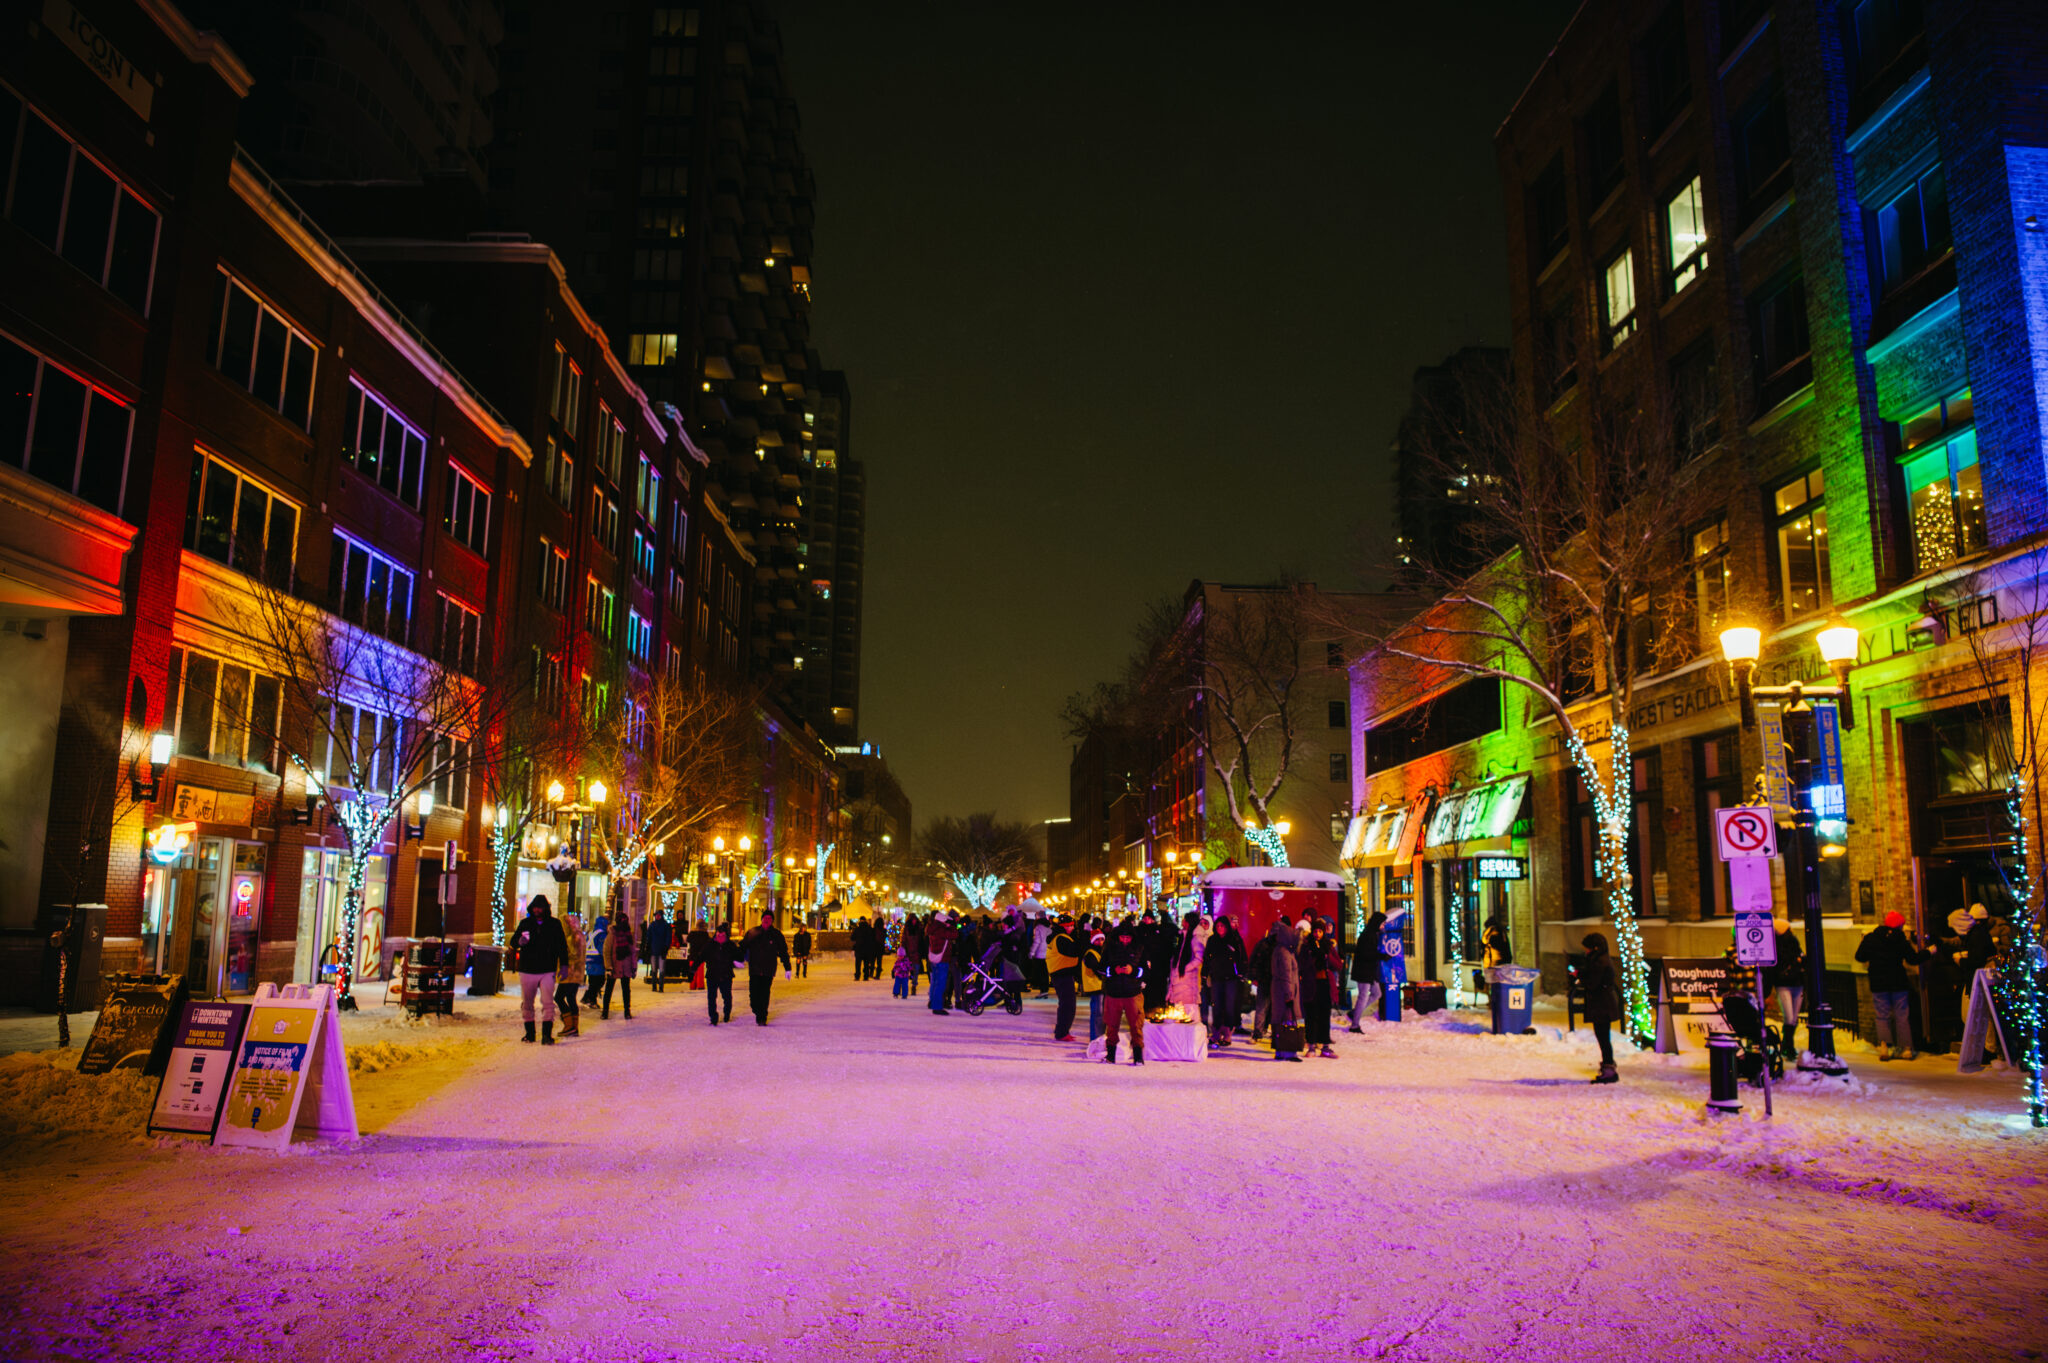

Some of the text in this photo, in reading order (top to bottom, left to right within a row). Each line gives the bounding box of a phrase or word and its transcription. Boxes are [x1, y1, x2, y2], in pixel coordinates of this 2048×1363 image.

[70, 8, 122, 78] ICON
[1578, 718, 1613, 746] GREA
[1627, 701, 1666, 731] WEST
[1479, 859, 1520, 872] SEOUL
[1668, 967, 1727, 981] Doughnuts
[428, 977, 448, 987] FRE
[1671, 981, 1681, 993] &
[1512, 996, 1521, 1005] H
[122, 1002, 165, 1016] credo
[199, 1008, 233, 1019] DOWNTOWN
[189, 1029, 226, 1039] THANK YOU TO
[185, 1037, 225, 1048] OUR SPONSORS
[254, 1047, 272, 1056] NOTICE
[271, 1047, 278, 1056] OF
